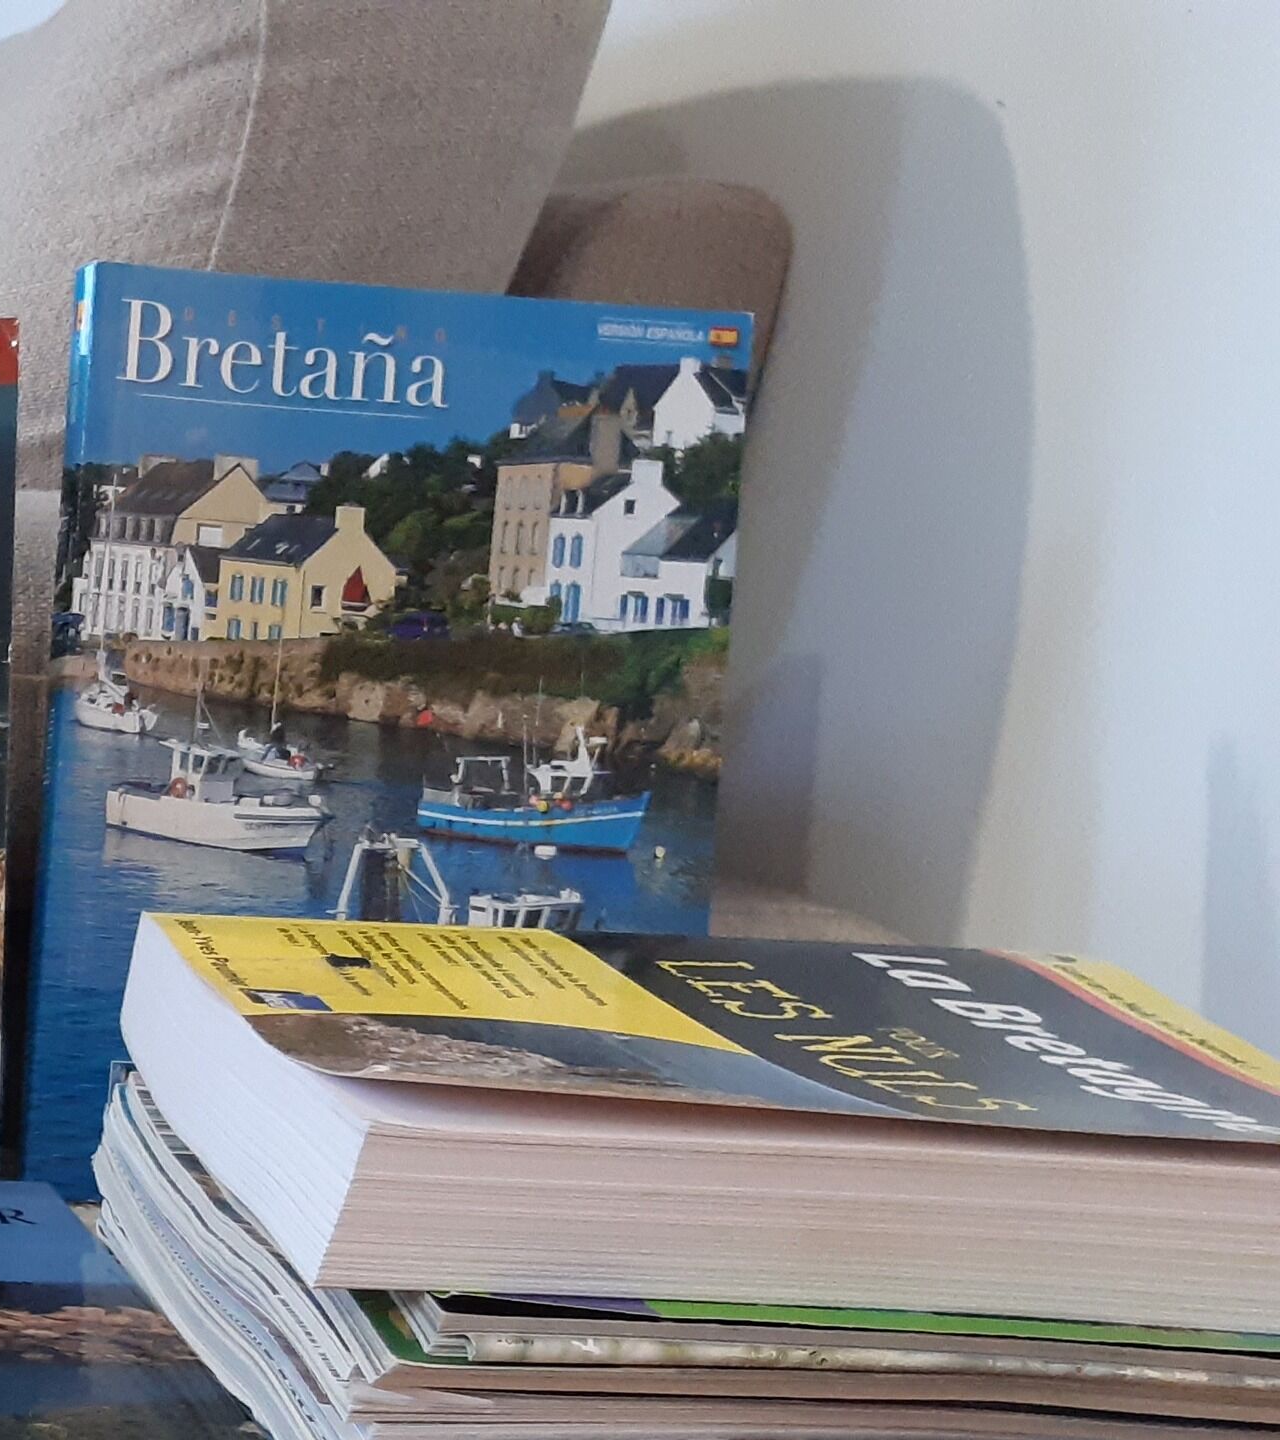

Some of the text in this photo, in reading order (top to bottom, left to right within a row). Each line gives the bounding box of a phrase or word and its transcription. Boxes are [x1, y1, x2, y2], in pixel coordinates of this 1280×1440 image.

[115, 297, 449, 410] Bretaña
[851, 951, 974, 993] La
[655, 960, 835, 1020] LES
[773, 1033, 1039, 1112] NULS
